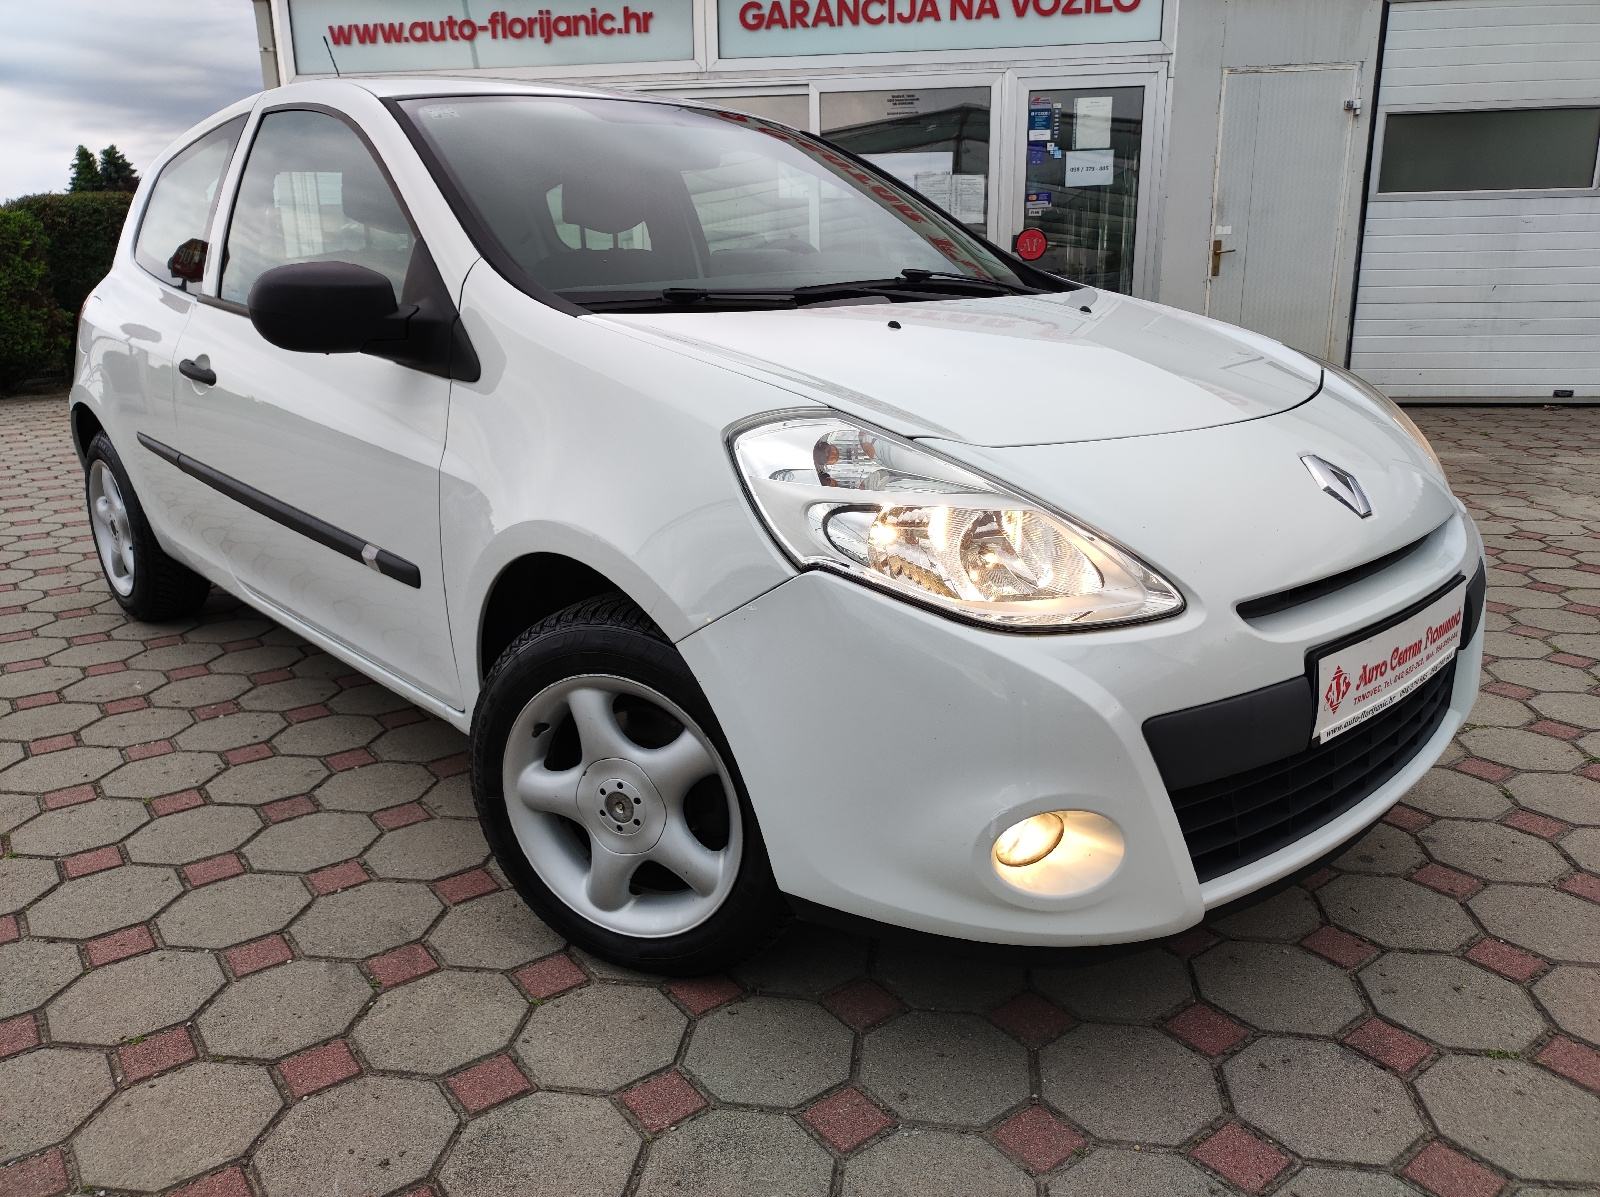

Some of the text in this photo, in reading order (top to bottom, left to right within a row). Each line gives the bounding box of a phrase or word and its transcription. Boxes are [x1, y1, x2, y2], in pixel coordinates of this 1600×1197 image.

[328, 6, 653, 46] www.auto-florijanic.hr
[739, 0, 941, 31] GARANCIJA
[950, 0, 1000, 20] NA
